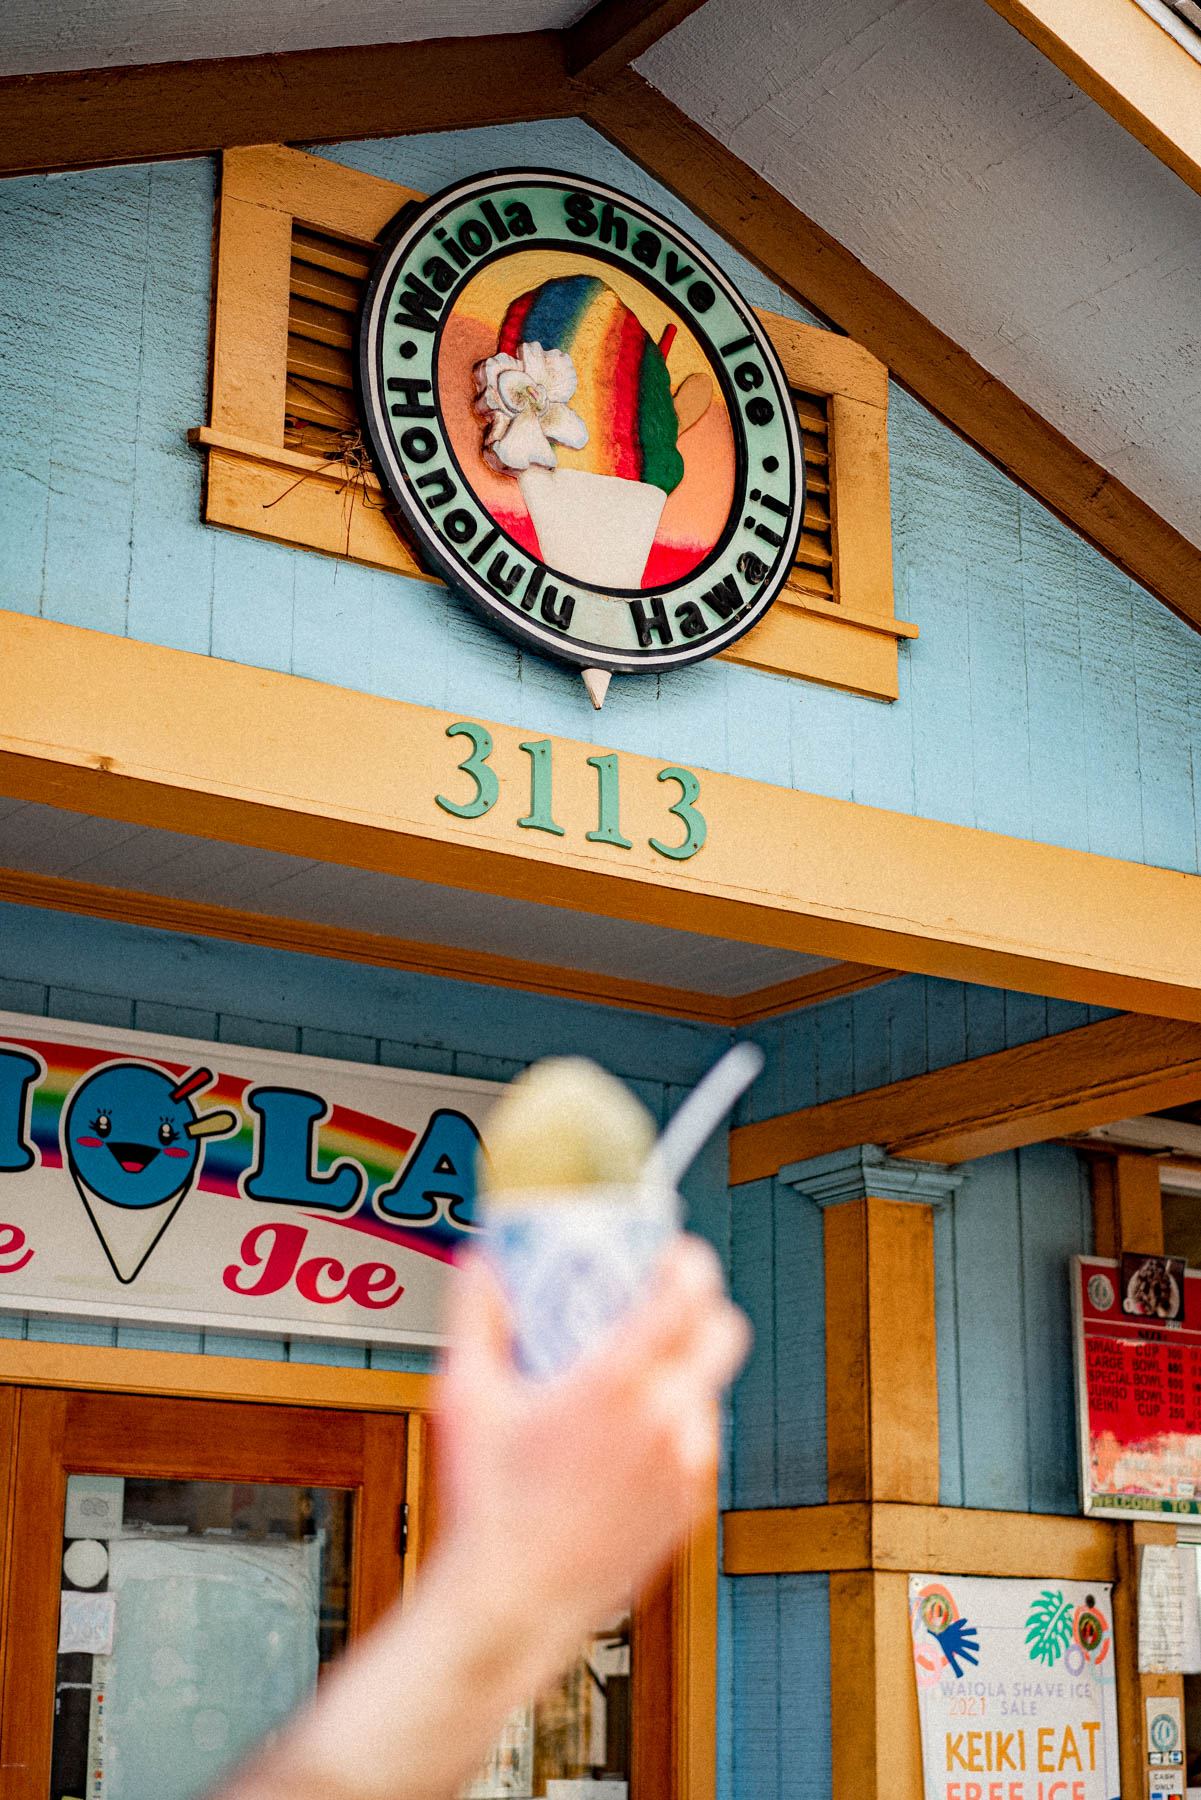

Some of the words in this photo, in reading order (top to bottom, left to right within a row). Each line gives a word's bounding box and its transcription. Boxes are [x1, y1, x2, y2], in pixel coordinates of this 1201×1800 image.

[395, 199, 538, 332] Waiola
[564, 192, 717, 315] Shave
[721, 333, 775, 427] Ice
[387, 376, 576, 631] Honolulu
[629, 488, 793, 648] Hawaii
[434, 721, 708, 861] 3113
[222, 1222, 405, 1310] Ice
[1087, 1340, 1123, 1355] SMALL
[1135, 1344, 1159, 1358] CUP
[1087, 1354, 1124, 1371] LARGE
[1132, 1359, 1163, 1374] BOWL
[1088, 1369, 1132, 1386] SPECIAL
[1133, 1373, 1165, 1389] BOWL
[1089, 1384, 1128, 1400] JUMBO
[1134, 1388, 1166, 1405] BOWL
[1090, 1398, 1119, 1414] KEIKI
[1137, 1403, 1161, 1417] CUP
[1092, 1495, 1163, 1512] WELCOME
[1172, 1500, 1191, 1513] TO
[940, 1681, 1007, 1698] WAIOLA
[1013, 1682, 1064, 1698] SHAVE
[1070, 1683, 1092, 1699] ICE
[949, 1696, 987, 1717] 2021
[1000, 1700, 1038, 1717] SALE
[945, 1728, 1026, 1772] KEIKI
[1037, 1721, 1101, 1773] EAT
